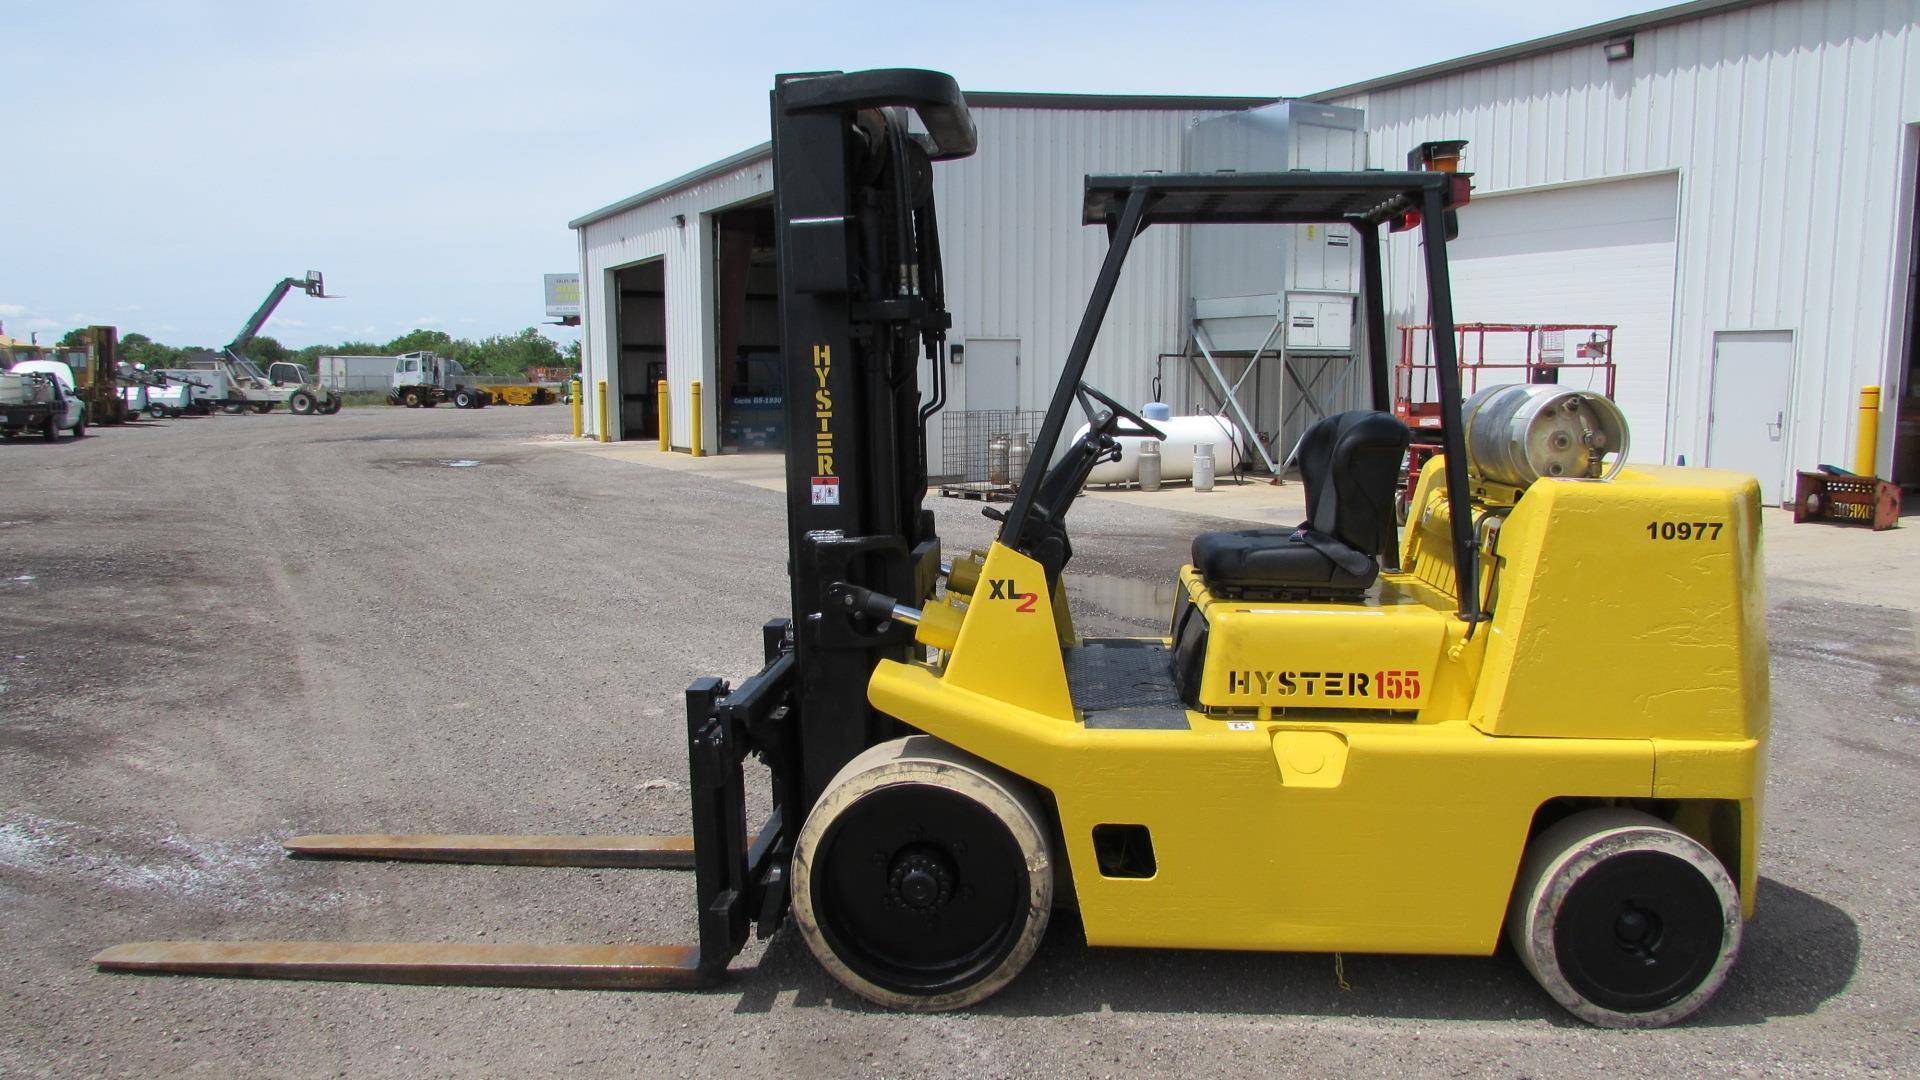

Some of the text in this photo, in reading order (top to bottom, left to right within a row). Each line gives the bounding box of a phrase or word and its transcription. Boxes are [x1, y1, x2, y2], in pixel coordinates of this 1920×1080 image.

[813, 345, 834, 476] HYSTER
[1646, 521, 1723, 541] 10977
[1229, 671, 1421, 699] HYSTER 155
